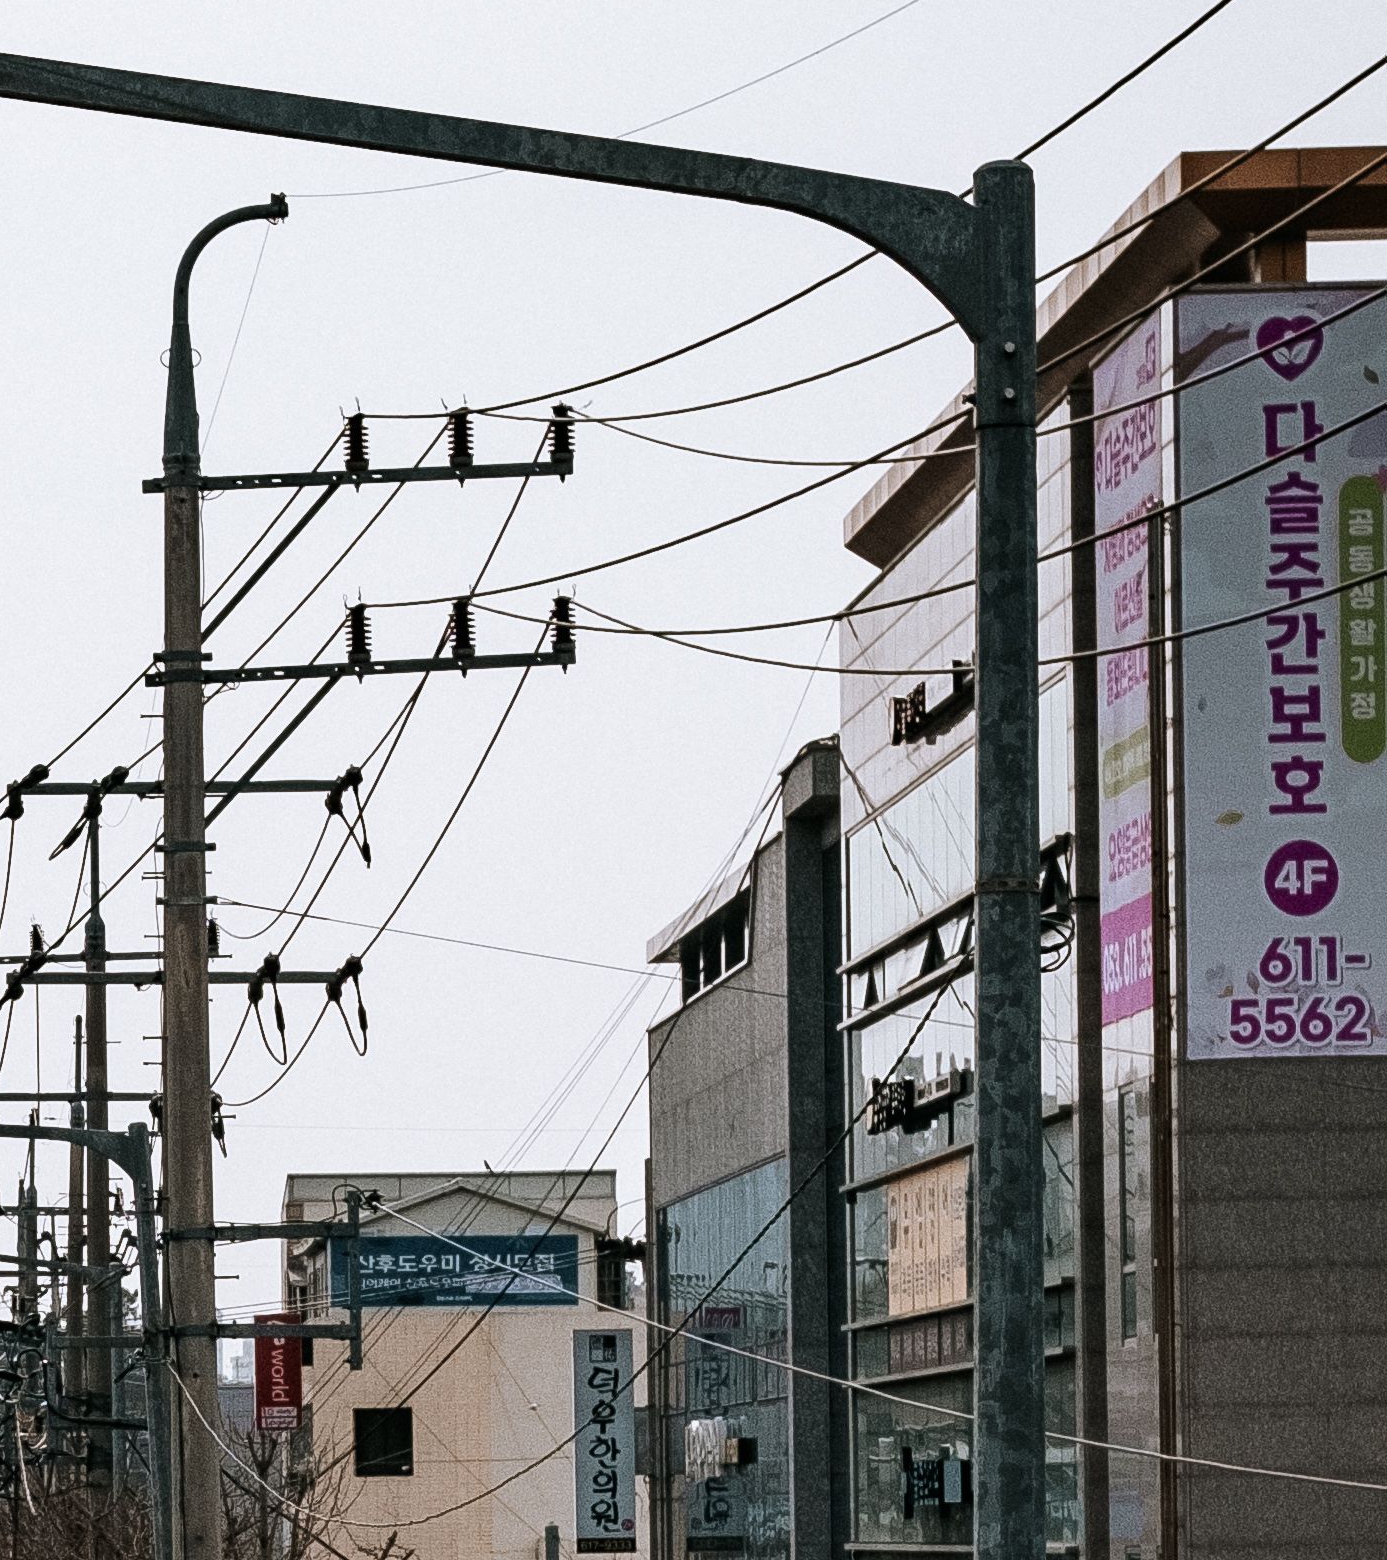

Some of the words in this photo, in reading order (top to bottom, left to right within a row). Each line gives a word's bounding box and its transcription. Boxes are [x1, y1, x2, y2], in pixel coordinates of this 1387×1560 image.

[1262, 401, 1327, 817] 다슬주간보호
[1348, 507, 1379, 720] 공동생활가정
[1274, 861, 1329, 897] 4F
[1259, 935, 1370, 985] 611-
[1229, 996, 1371, 1045] 5562
[359, 1255, 460, 1274] 산후도우미
[271, 1349, 290, 1402] world
[587, 1366, 621, 1533] 덕우한의원
